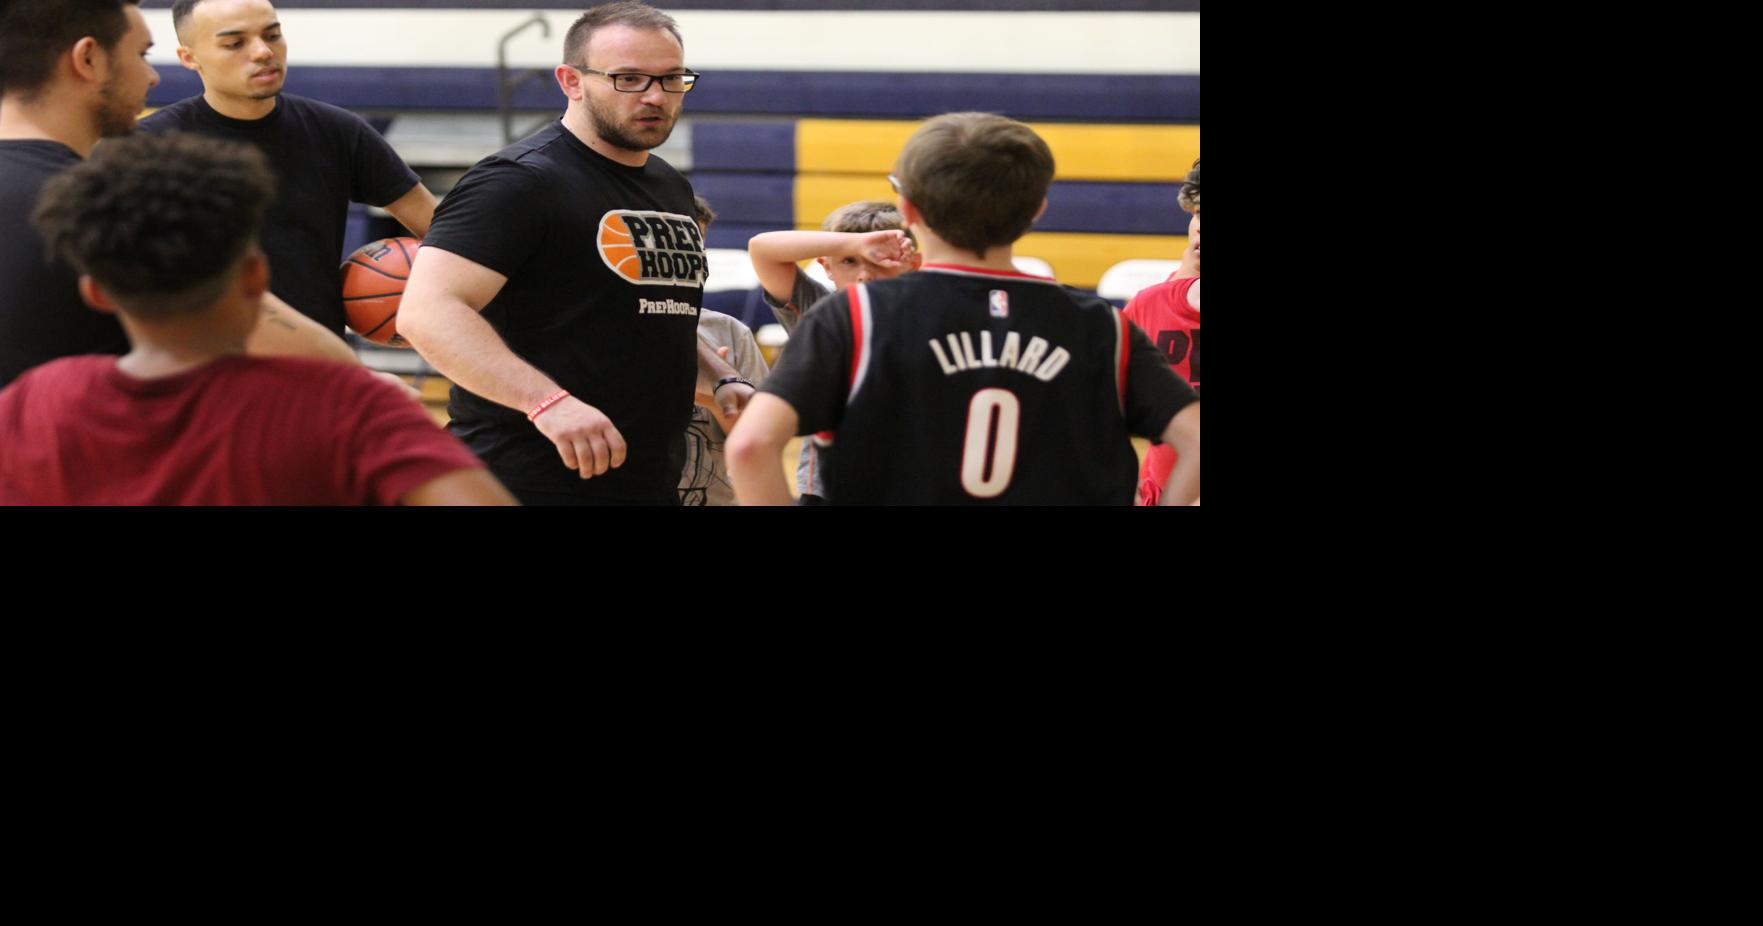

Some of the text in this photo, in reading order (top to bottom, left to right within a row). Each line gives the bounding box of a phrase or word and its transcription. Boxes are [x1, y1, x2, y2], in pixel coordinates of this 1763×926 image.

[620, 215, 702, 253] PREP
[928, 330, 1071, 382] LILLARD
[960, 387, 1020, 499] 0
